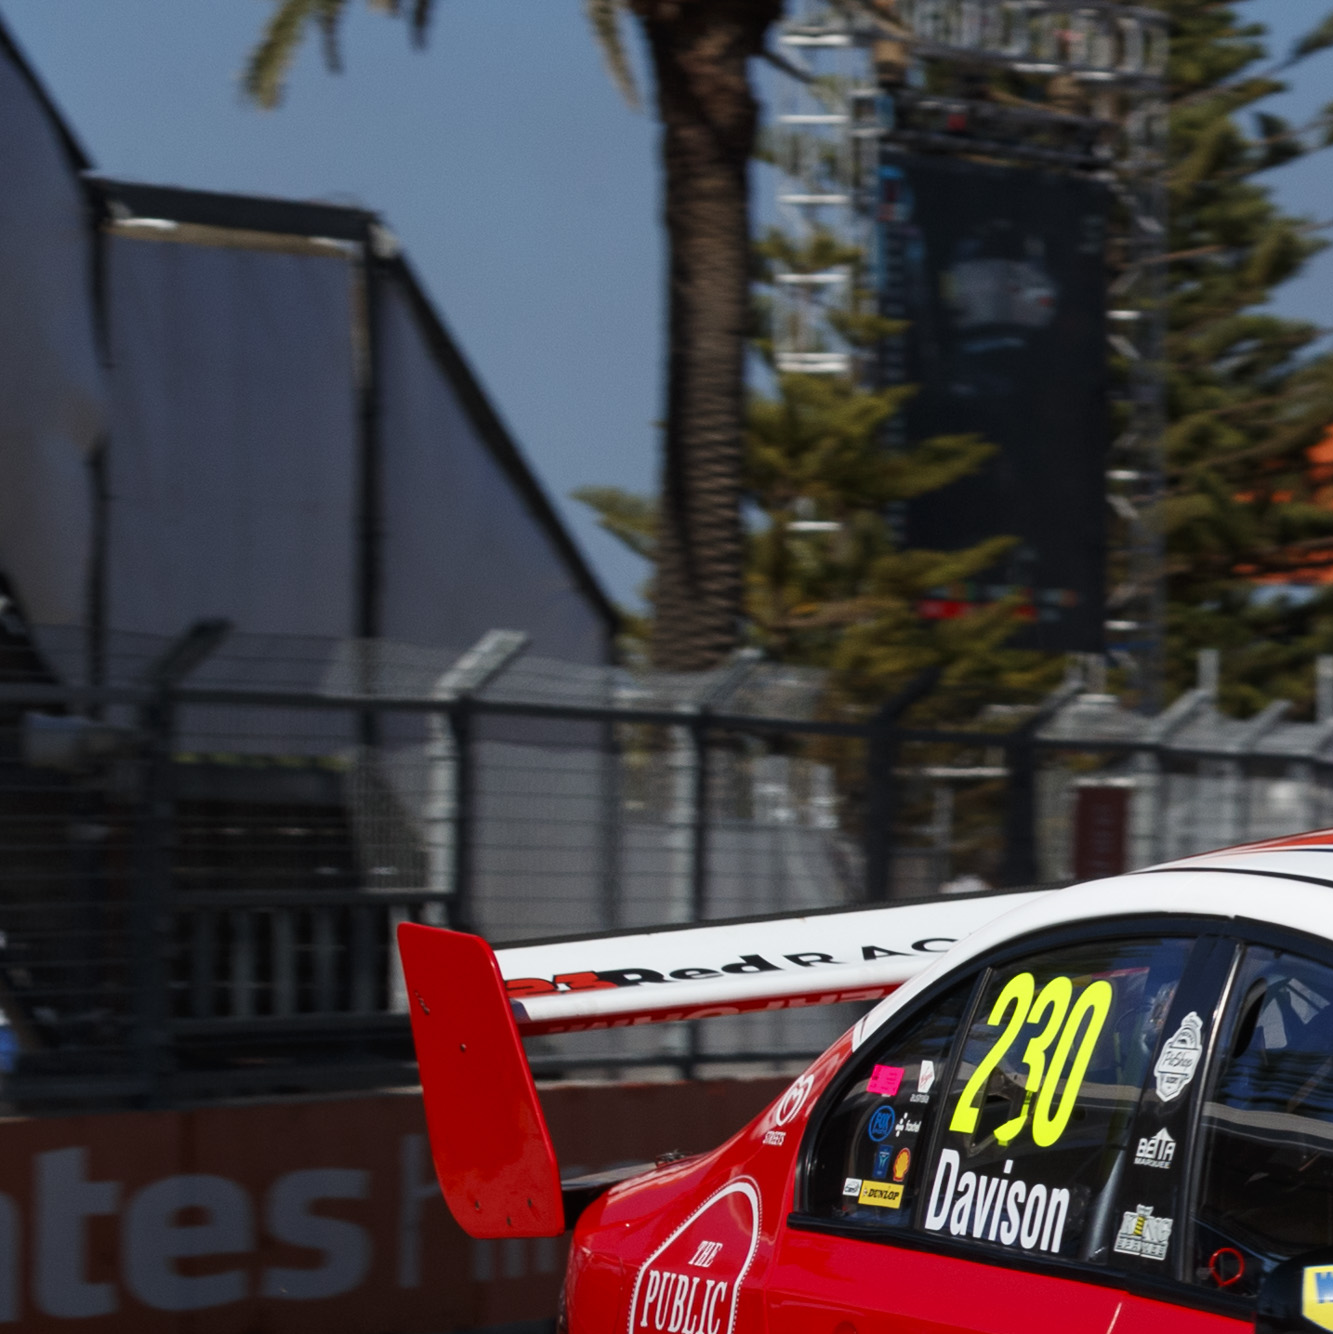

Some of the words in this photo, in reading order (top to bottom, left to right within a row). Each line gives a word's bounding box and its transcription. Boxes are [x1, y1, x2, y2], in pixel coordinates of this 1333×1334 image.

[949, 972, 1112, 1147] 230
[868, 1189, 899, 1201] DUNLOP
[925, 1149, 1070, 1253] Davison
[689, 1240, 723, 1267] THE
